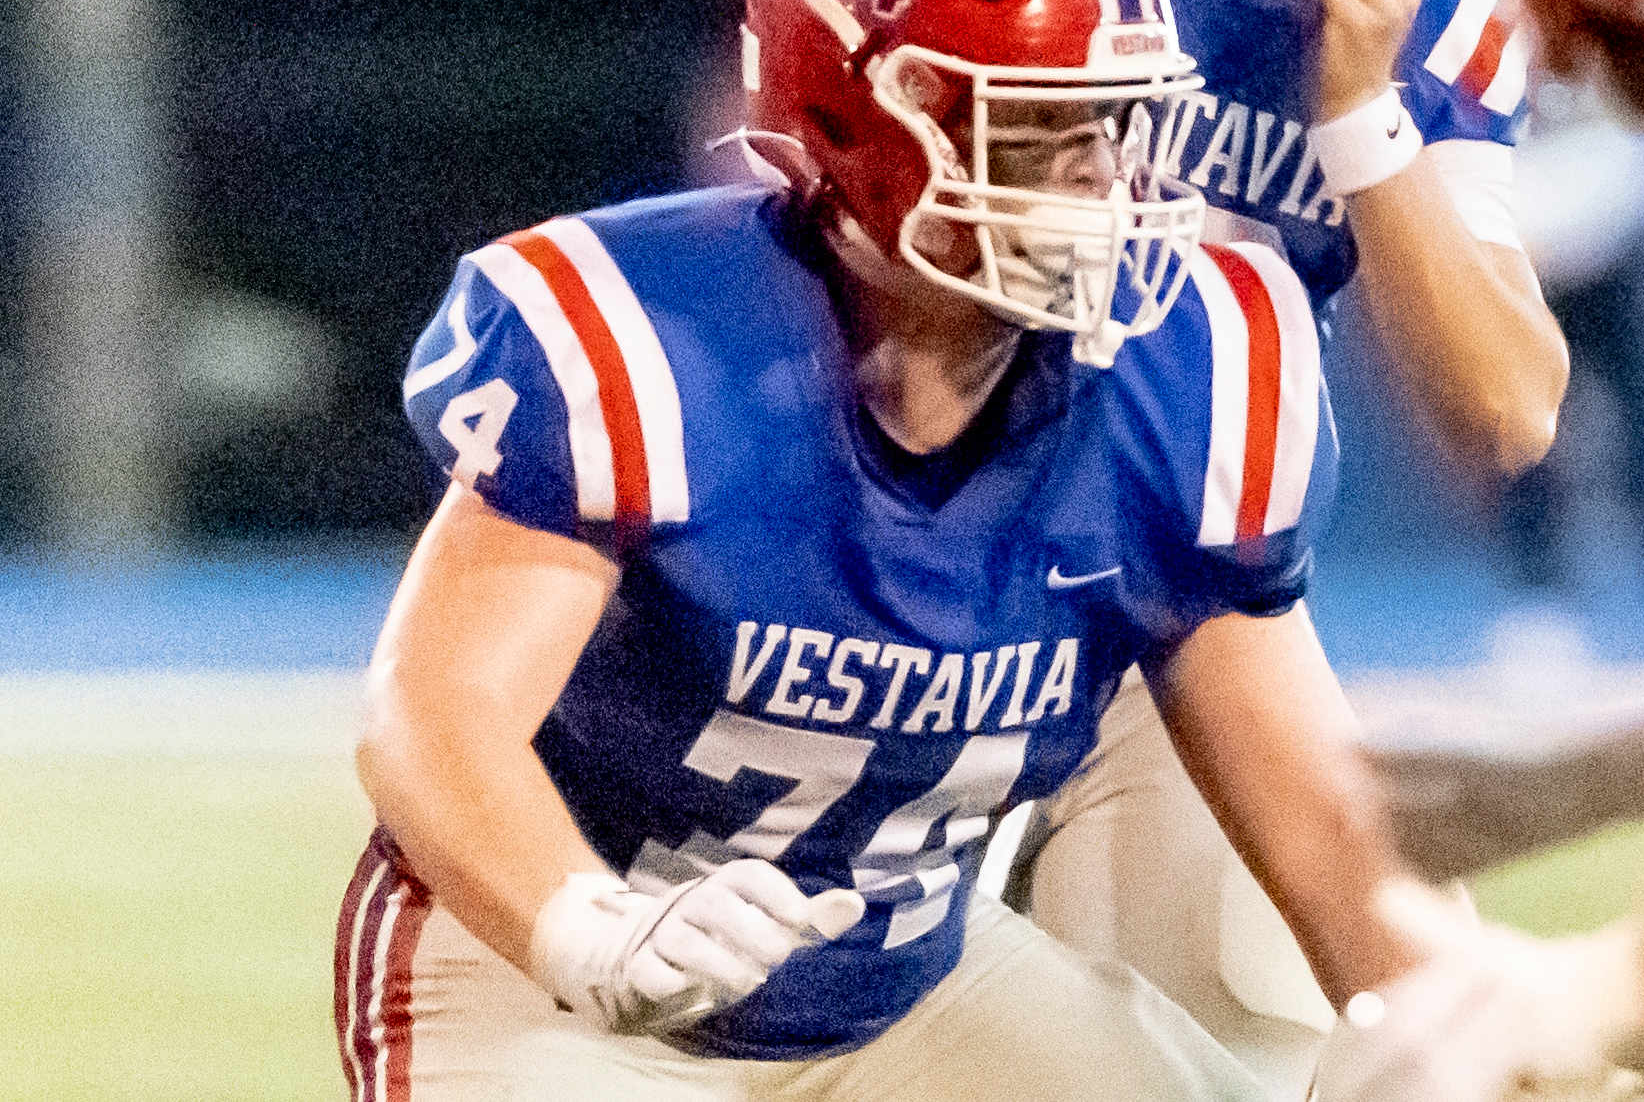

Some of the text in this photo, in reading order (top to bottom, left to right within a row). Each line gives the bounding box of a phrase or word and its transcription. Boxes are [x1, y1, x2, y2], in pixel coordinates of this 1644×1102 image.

[403, 290, 519, 484] 74
[726, 621, 1081, 733] VESTAVIA
[626, 708, 1031, 951] 74
